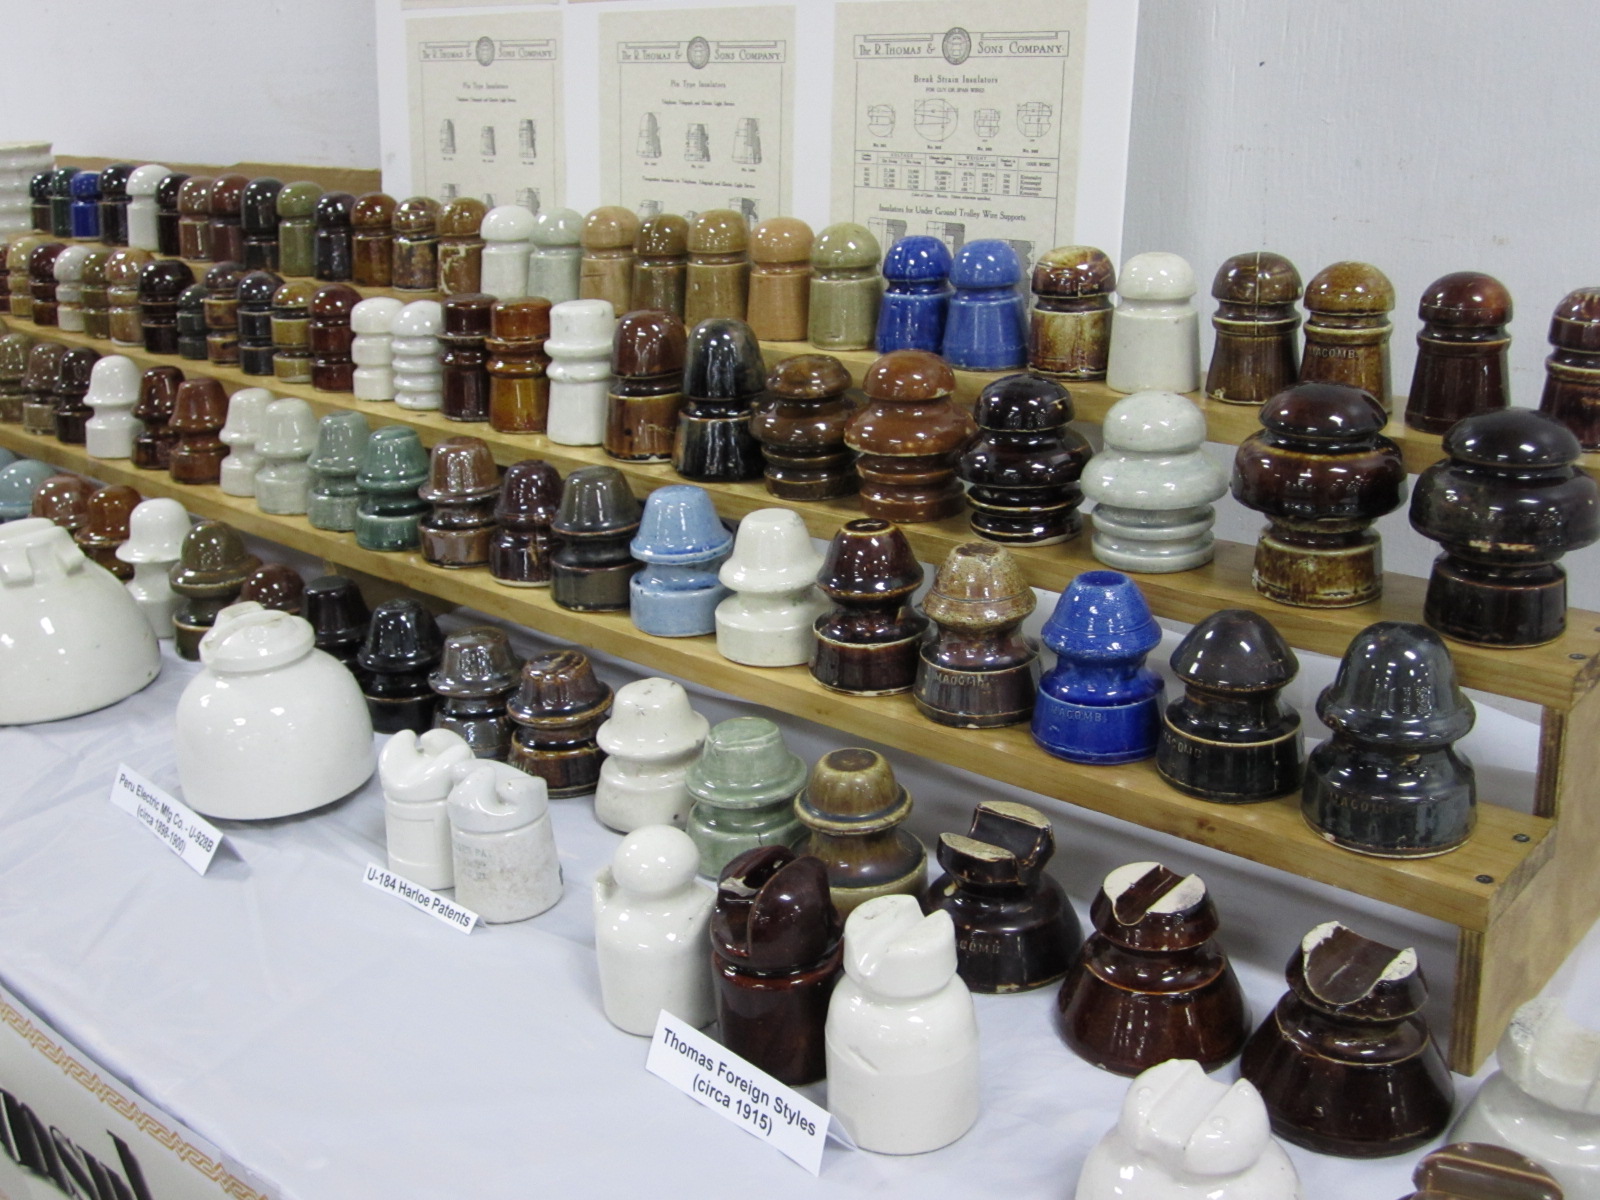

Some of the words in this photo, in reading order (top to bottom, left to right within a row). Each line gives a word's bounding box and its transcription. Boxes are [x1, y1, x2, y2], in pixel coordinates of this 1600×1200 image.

[714, 49, 735, 60] SONS
[739, 49, 780, 60] COMPANY
[885, 43, 922, 56] THOMAS
[926, 42, 936, 55] &
[978, 41, 1004, 54] SONS
[1009, 41, 1063, 54] COMPANY
[913, 74, 933, 83] Break
[936, 74, 959, 83] Strain
[962, 74, 998, 83] Insulators
[879, 203, 904, 213] Insulators
[915, 206, 933, 215] Under
[935, 207, 957, 216] Ground
[959, 208, 980, 218] Trolley
[983, 209, 998, 219] Wire
[1000, 211, 1026, 222] Supports
[119, 773, 135, 792] Peru
[136, 784, 160, 811] Electric
[160, 802, 173, 824] Mfg
[173, 813, 184, 831] Co.
[137, 804, 154, 826] (circa
[367, 867, 396, 890] U-184
[398, 881, 430, 907] Harloe
[432, 897, 471, 927] Patents
[663, 1027, 714, 1071] Thomas
[717, 1061, 769, 1106] Foreign
[774, 1096, 816, 1136] Styles
[693, 1073, 731, 1108] (circa
[736, 1099, 773, 1137] 1915)
